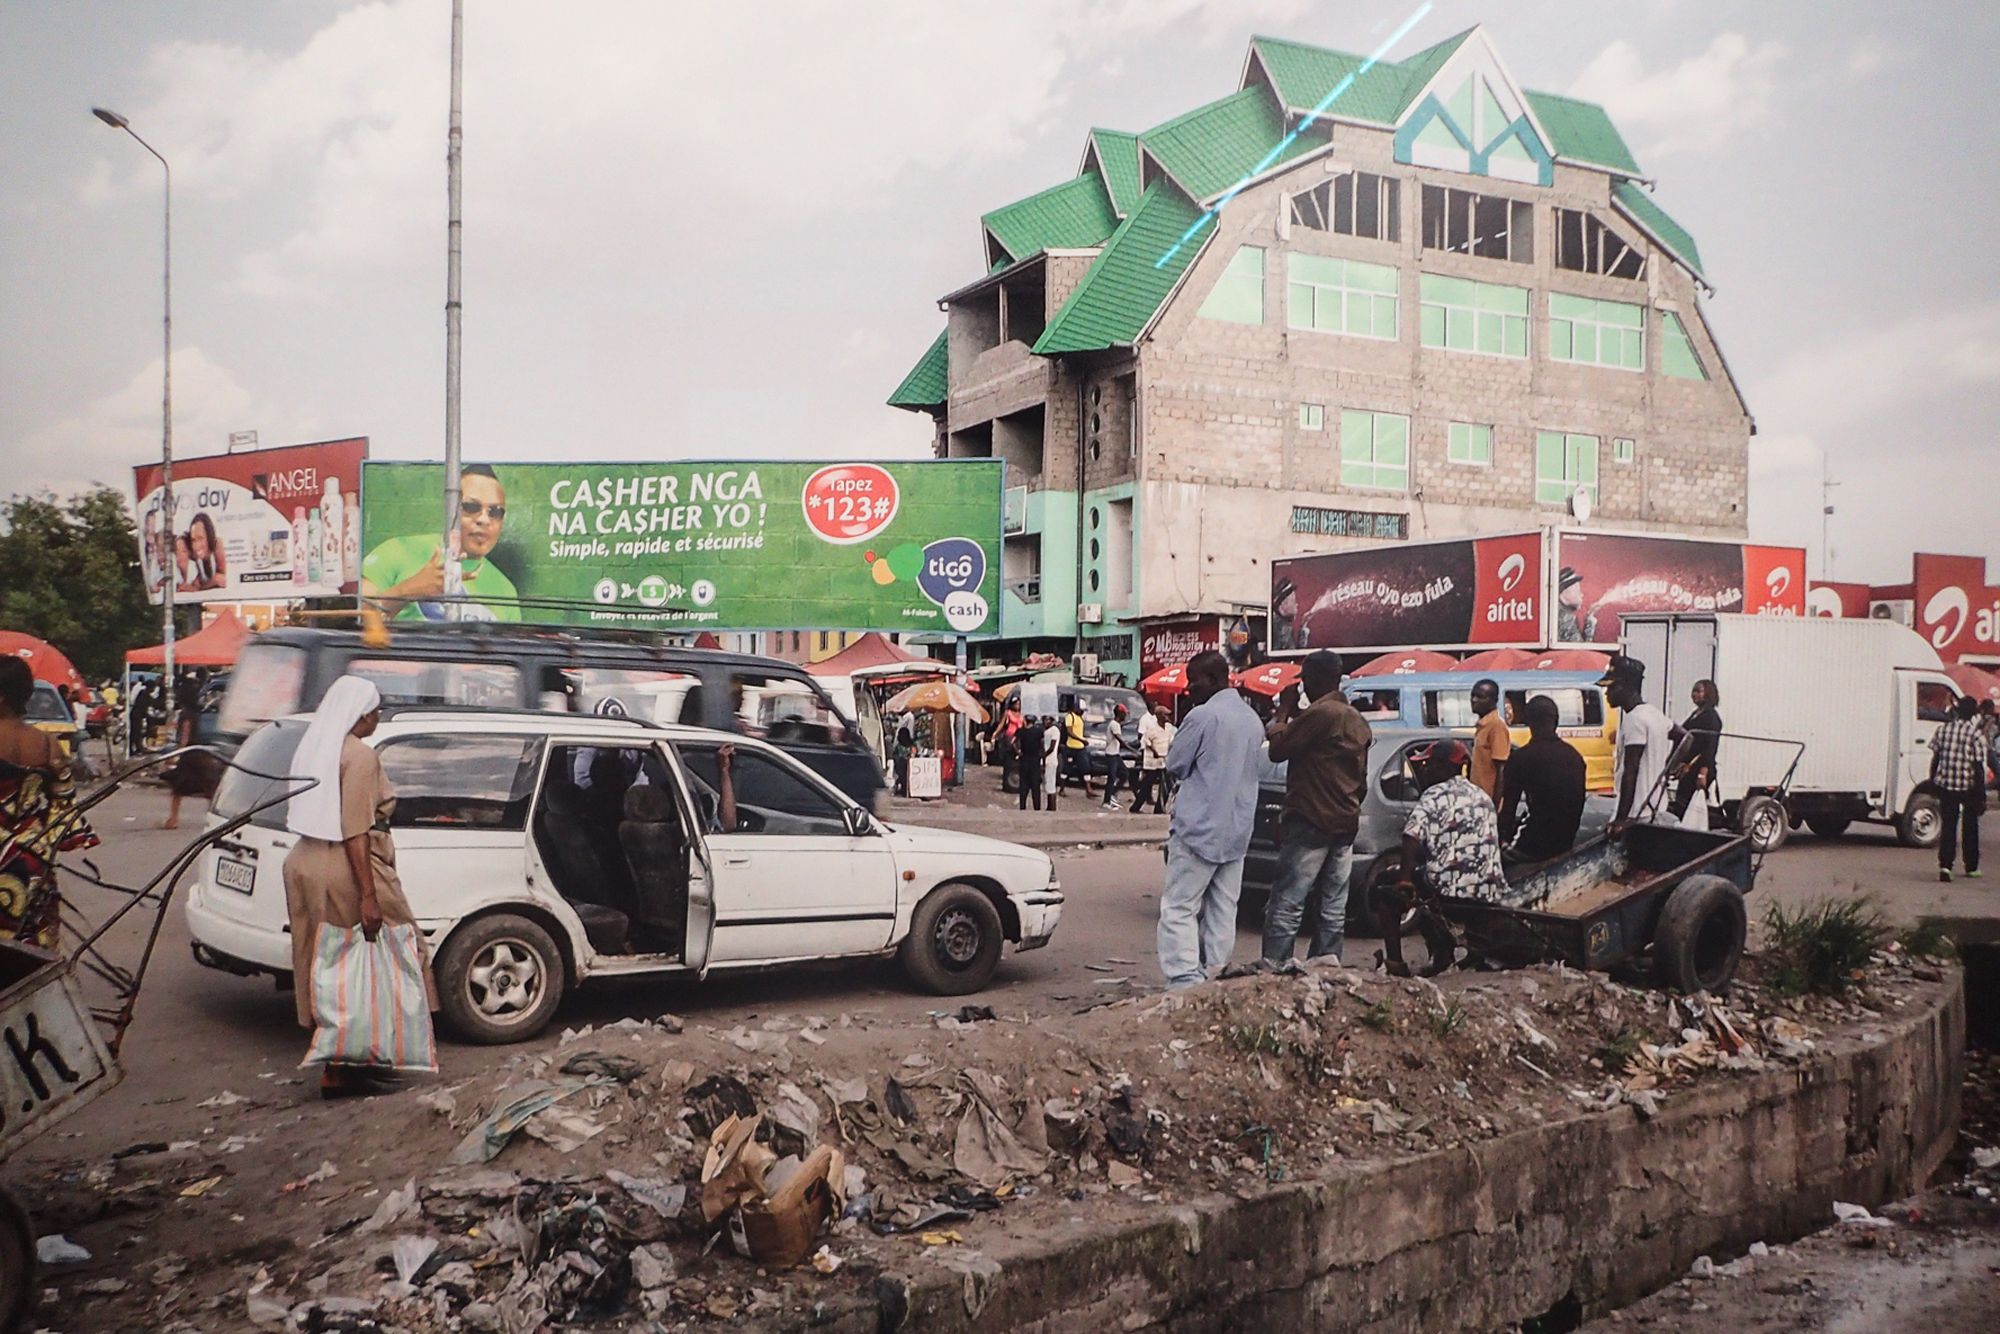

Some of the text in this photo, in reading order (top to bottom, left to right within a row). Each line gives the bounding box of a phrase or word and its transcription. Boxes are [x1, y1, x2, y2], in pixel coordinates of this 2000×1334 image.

[268, 468, 319, 492] ANGEL
[550, 471, 763, 510] CA$HER NGA
[830, 479, 873, 495] Tapez
[199, 486, 230, 511] day
[549, 511, 588, 536] NA
[595, 505, 702, 535] CA$HER
[712, 503, 751, 528] YO
[549, 531, 764, 560] Simple, rapide et sécurisé
[1331, 580, 1374, 605] réseau
[1376, 583, 1400, 605] oyo
[1424, 575, 1454, 604] fula
[948, 602, 983, 616] cash
[1486, 597, 1533, 623] airtel
[912, 760, 937, 775] SIM
